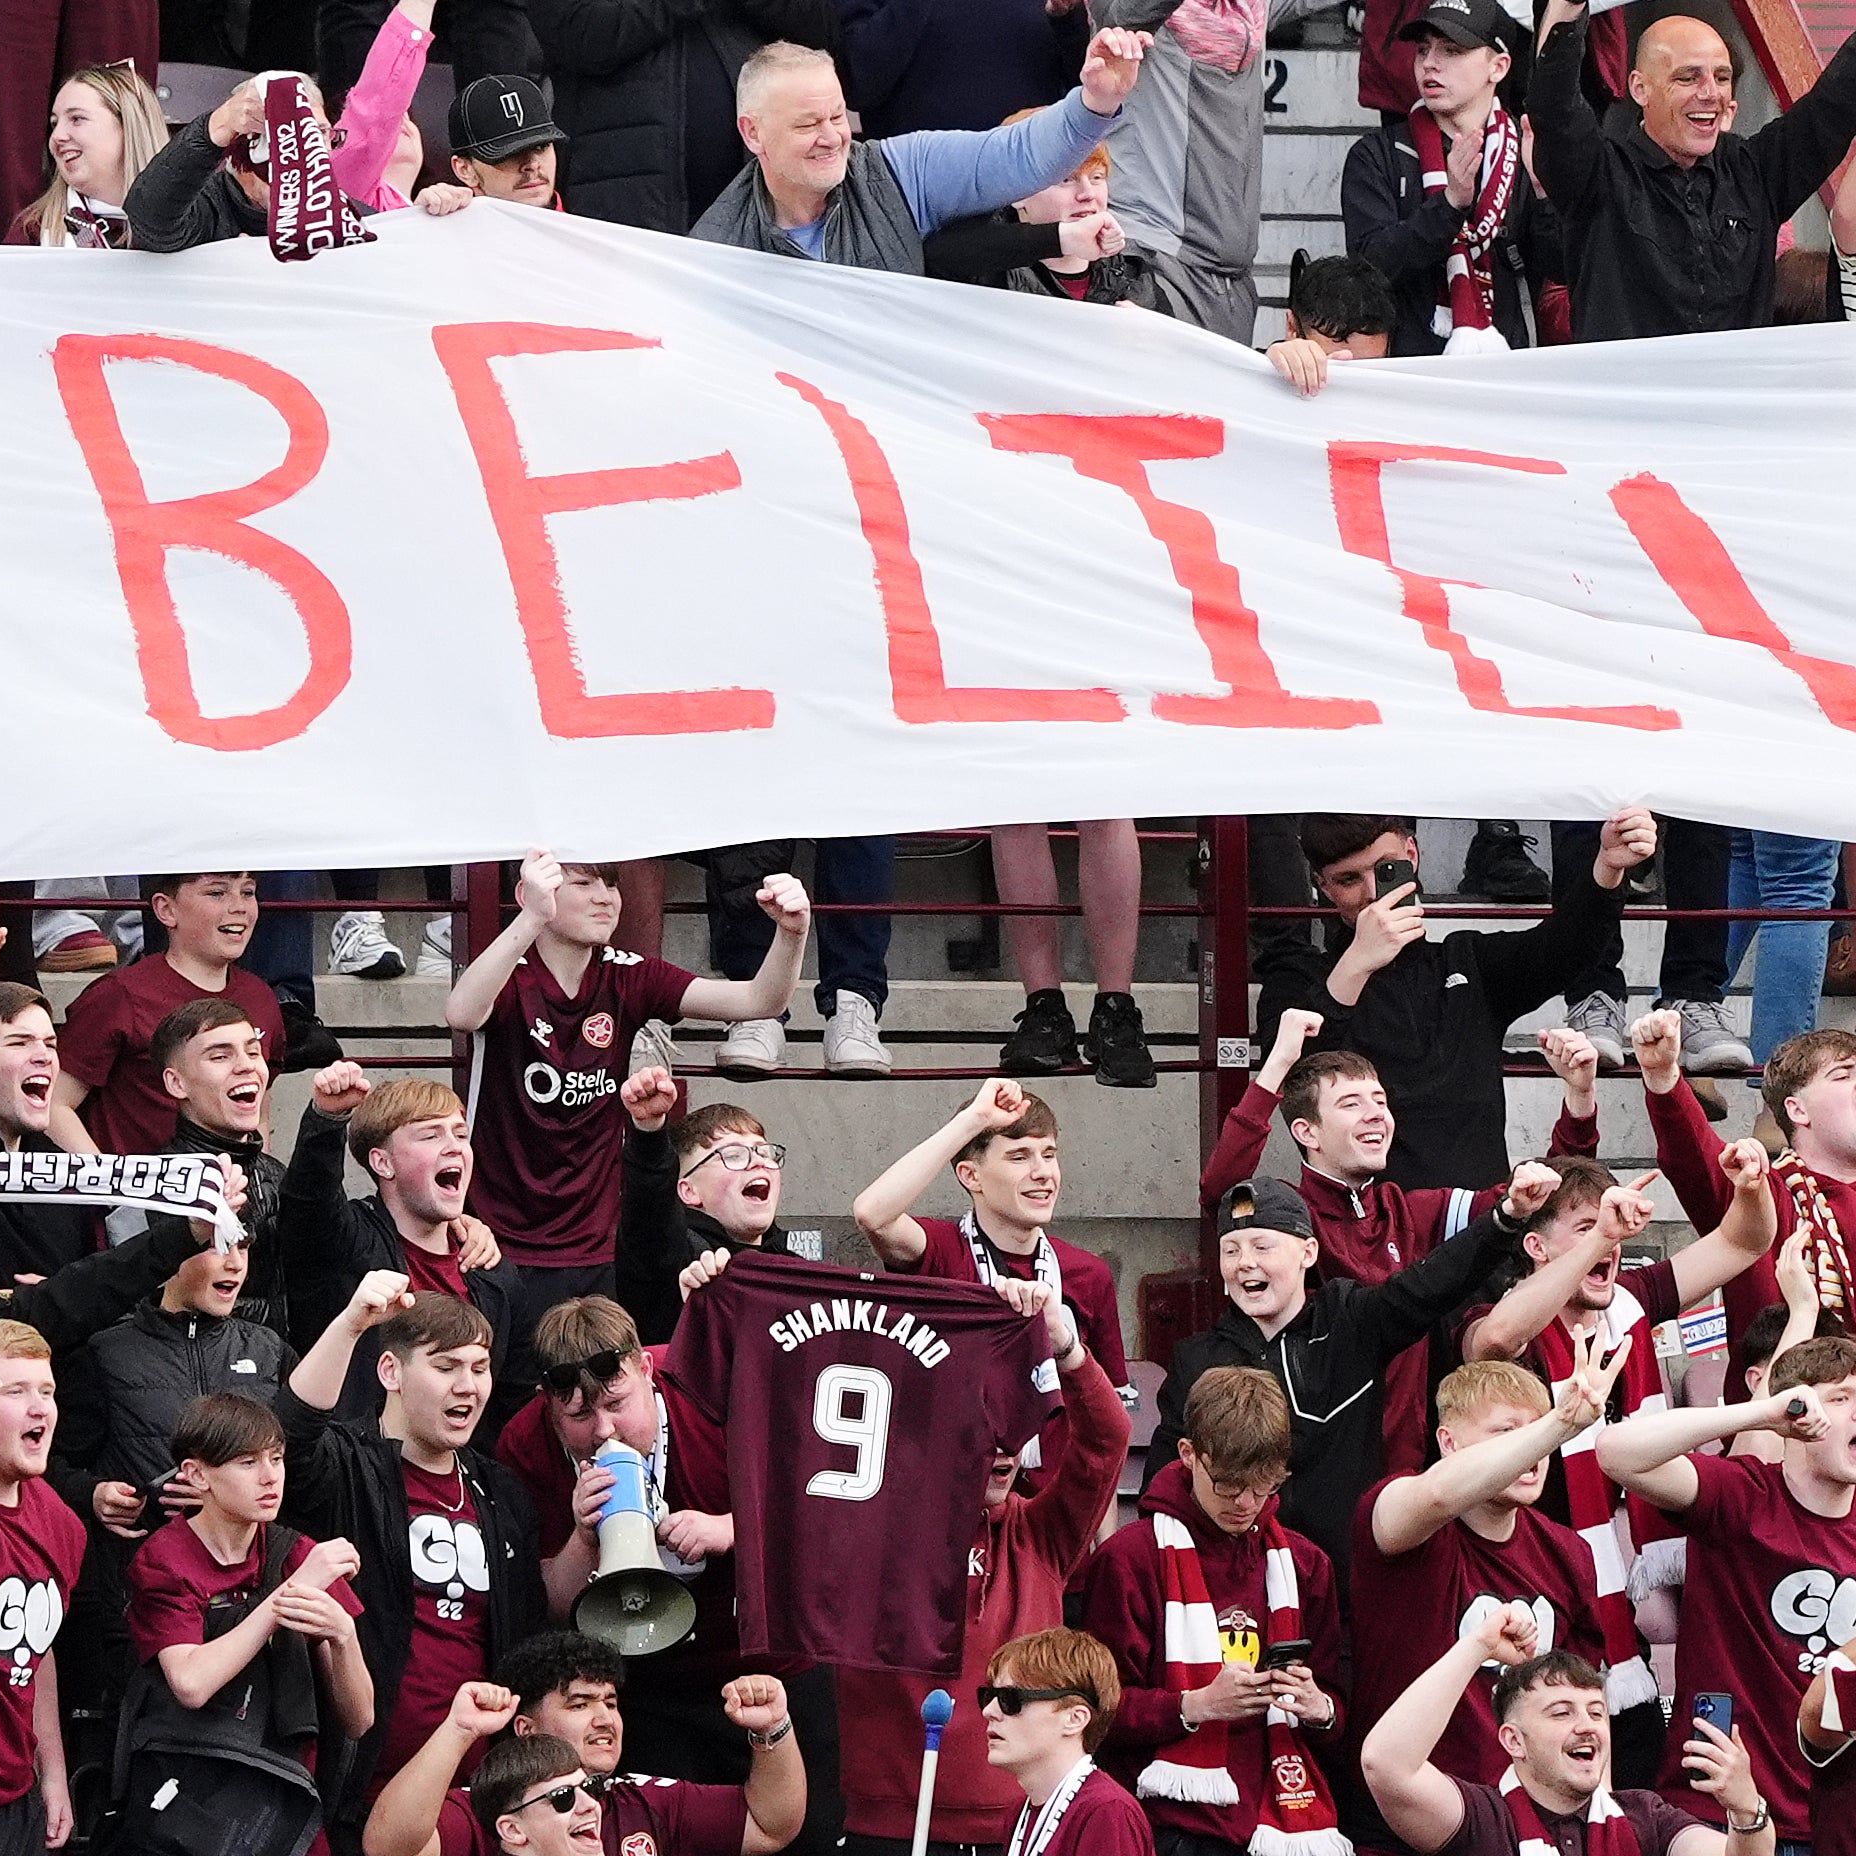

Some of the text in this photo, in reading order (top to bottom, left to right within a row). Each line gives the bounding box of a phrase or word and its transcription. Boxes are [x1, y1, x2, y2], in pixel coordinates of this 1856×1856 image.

[275, 120, 301, 256] WINNERS 2012
[1492, 139, 1519, 211] EASTER
[769, 1298, 951, 1369] SHANKLAND
[805, 1363, 893, 1503] 9
[436, 1598, 464, 1621] 22
[8, 1666, 32, 1687] 22
